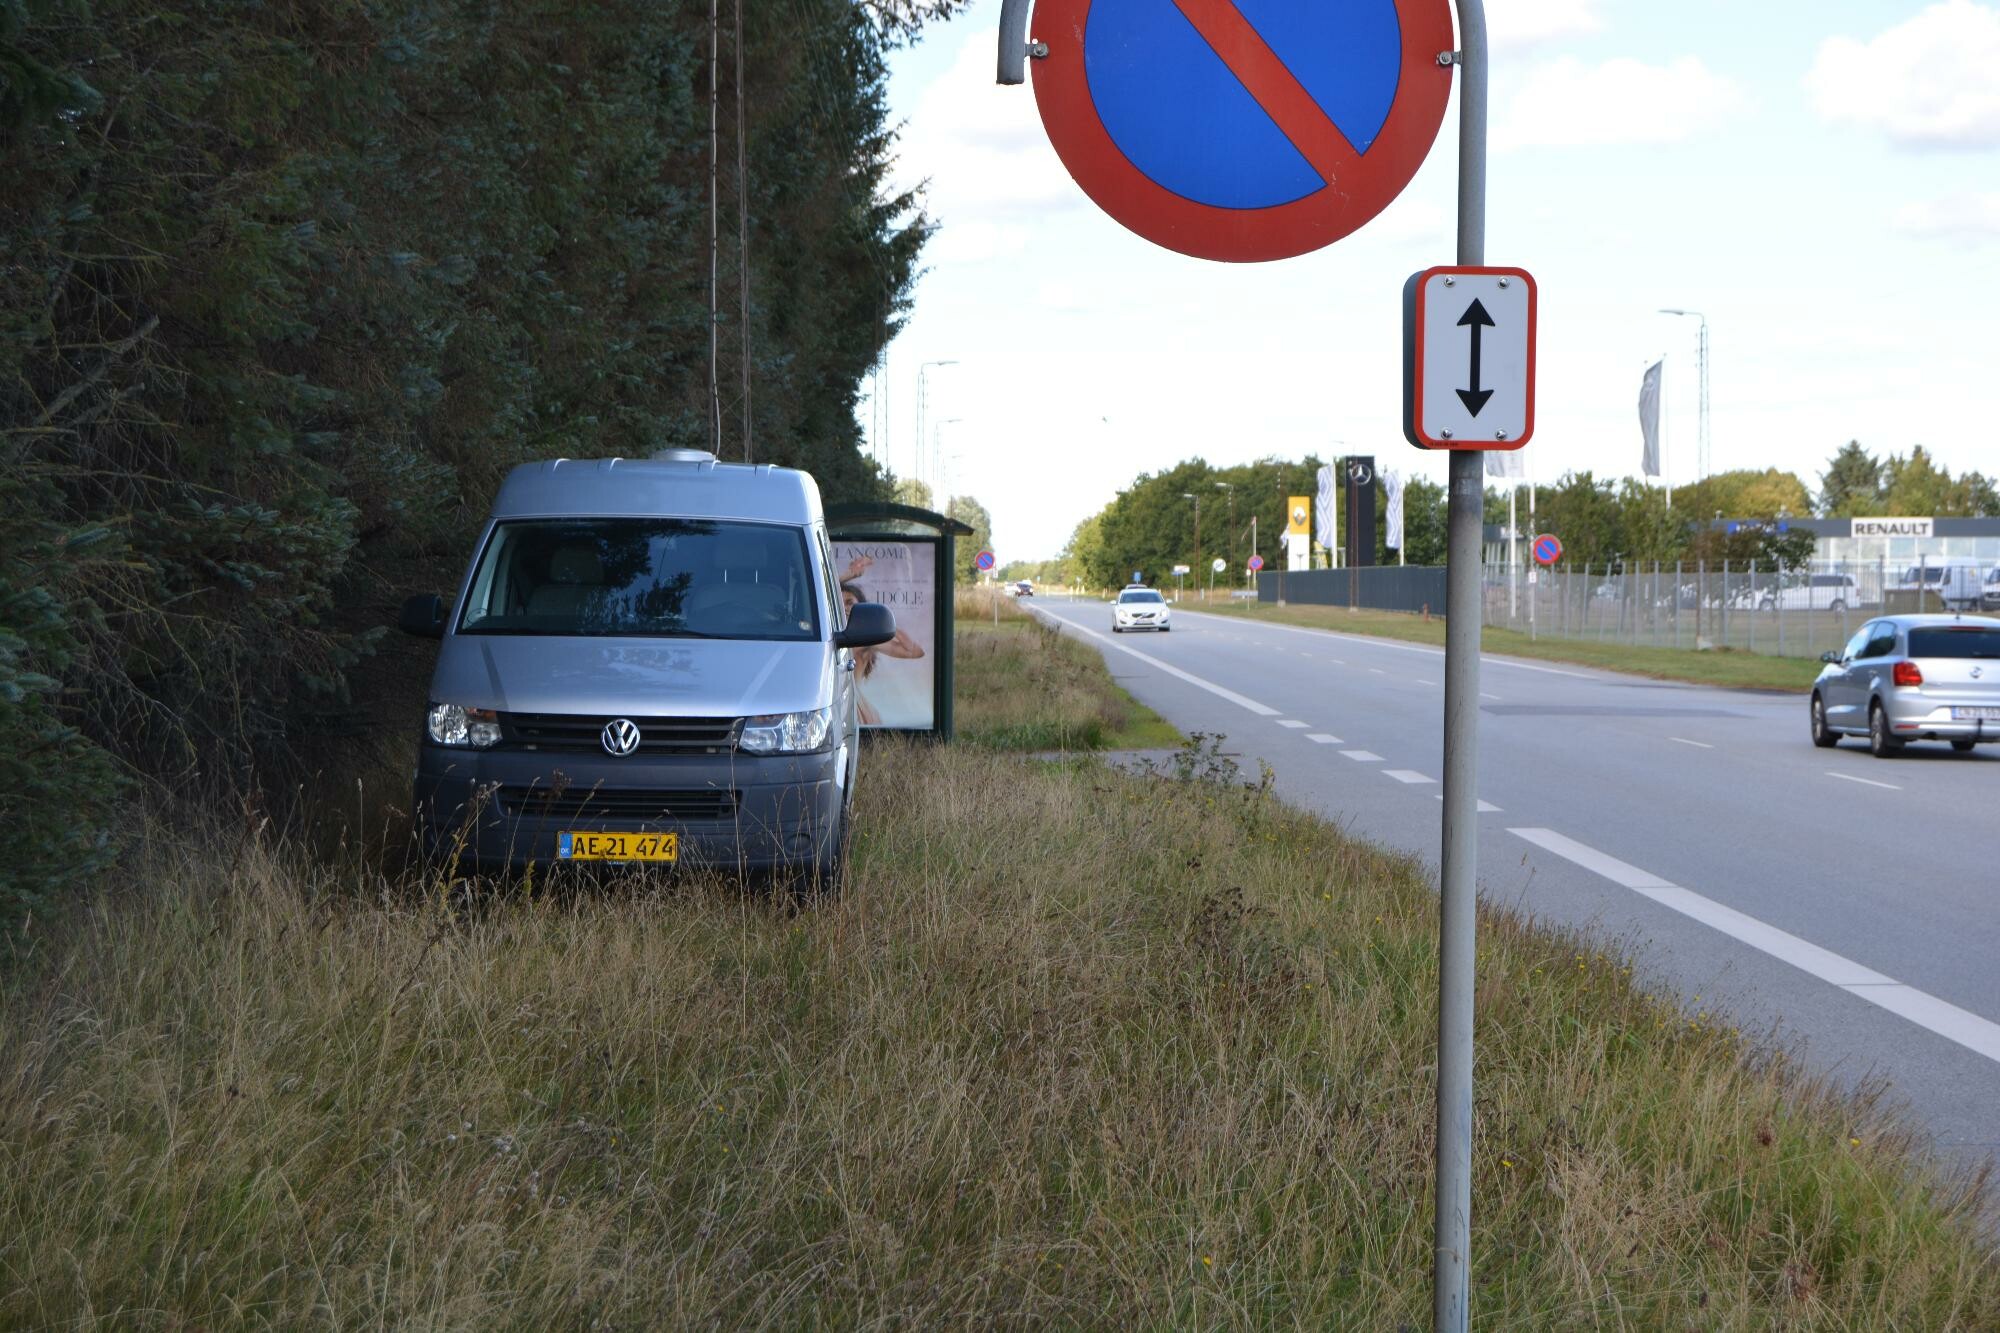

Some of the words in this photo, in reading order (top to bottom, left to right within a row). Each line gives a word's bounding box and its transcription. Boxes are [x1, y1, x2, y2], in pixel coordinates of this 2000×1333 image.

[1855, 523, 1929, 535] RENAULT
[573, 837, 599, 855] AE
[606, 837, 627, 856] 21
[636, 838, 673, 857] 474
